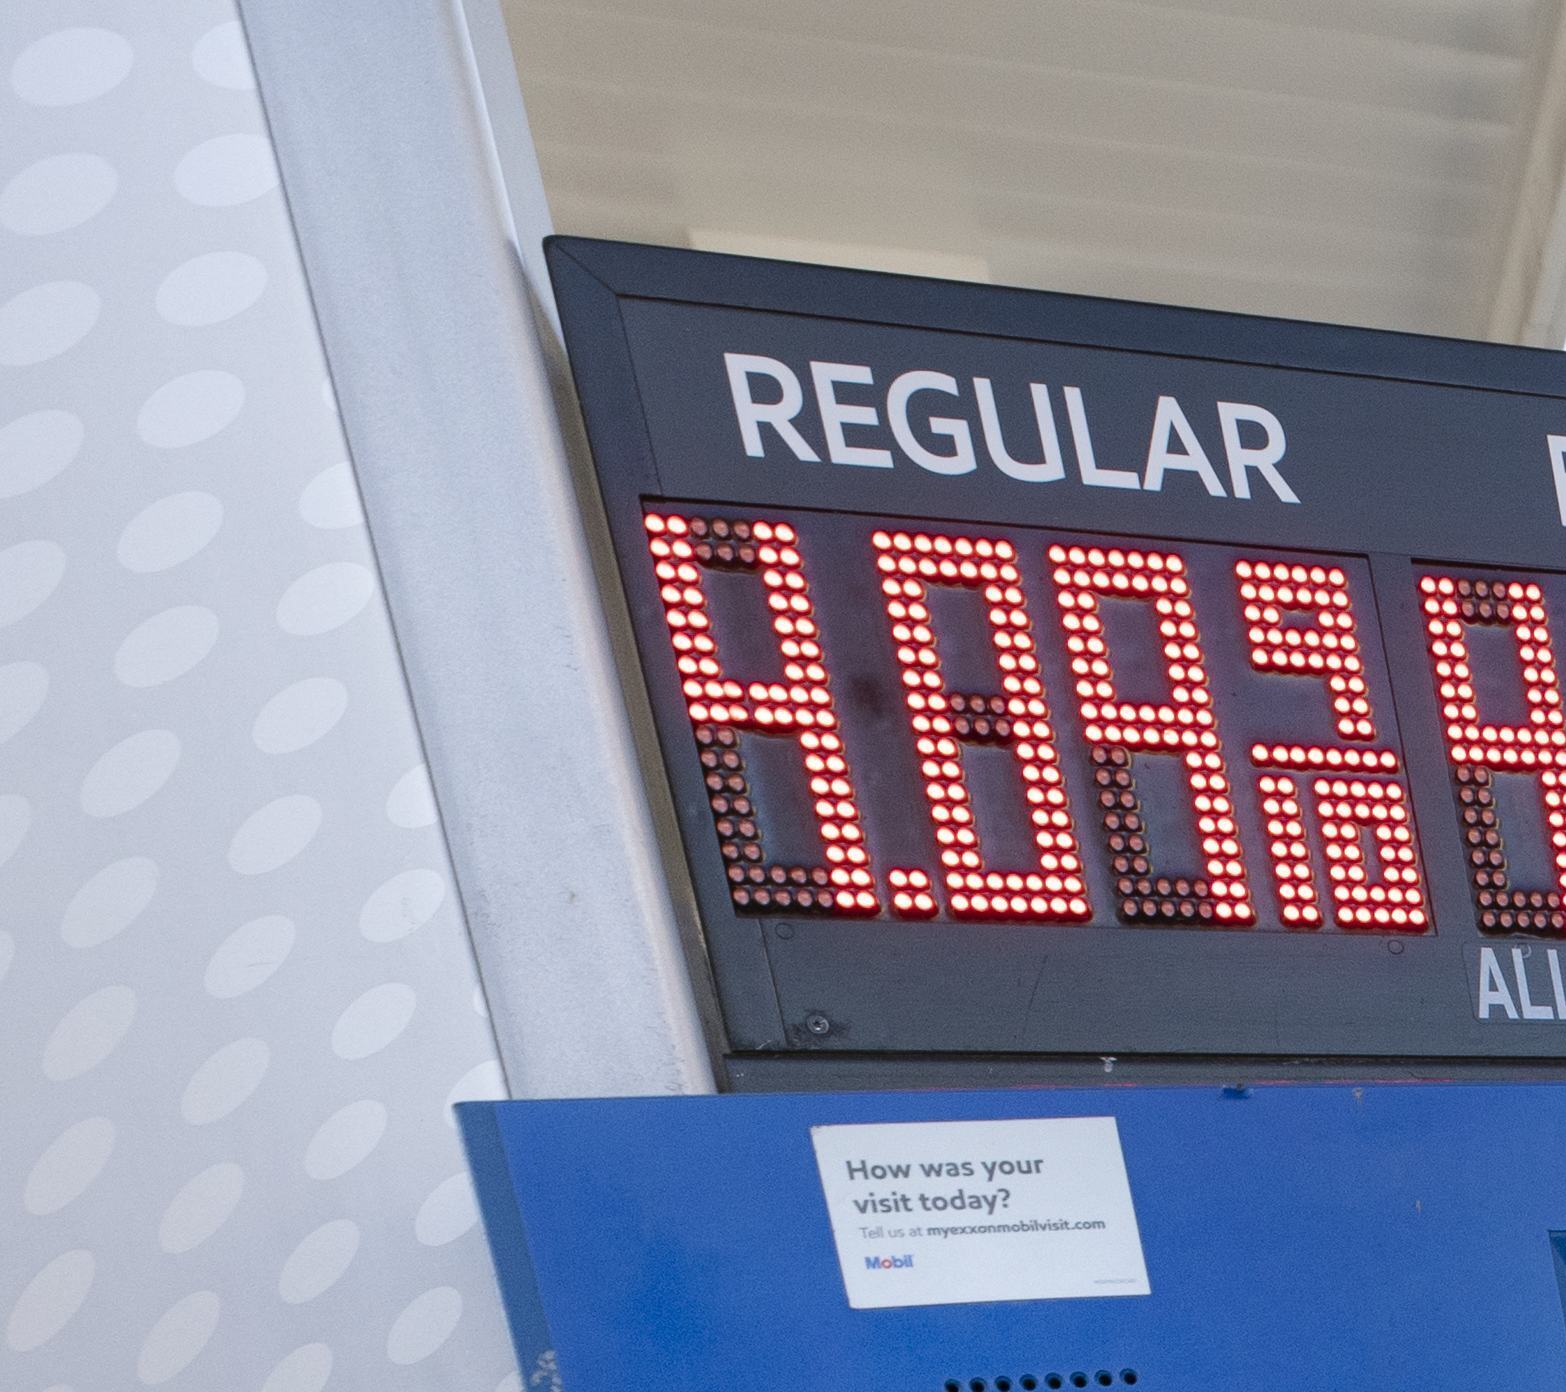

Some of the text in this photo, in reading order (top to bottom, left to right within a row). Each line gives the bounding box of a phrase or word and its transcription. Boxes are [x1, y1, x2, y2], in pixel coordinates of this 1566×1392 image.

[724, 351, 1302, 504] REGULAR
[846, 1159, 1044, 1181] How was your
[853, 1189, 1010, 1215] visit today?
[860, 1219, 1105, 1240] Tell us at myexxonmobilvisit.com
[865, 1254, 914, 1270] Mobil
